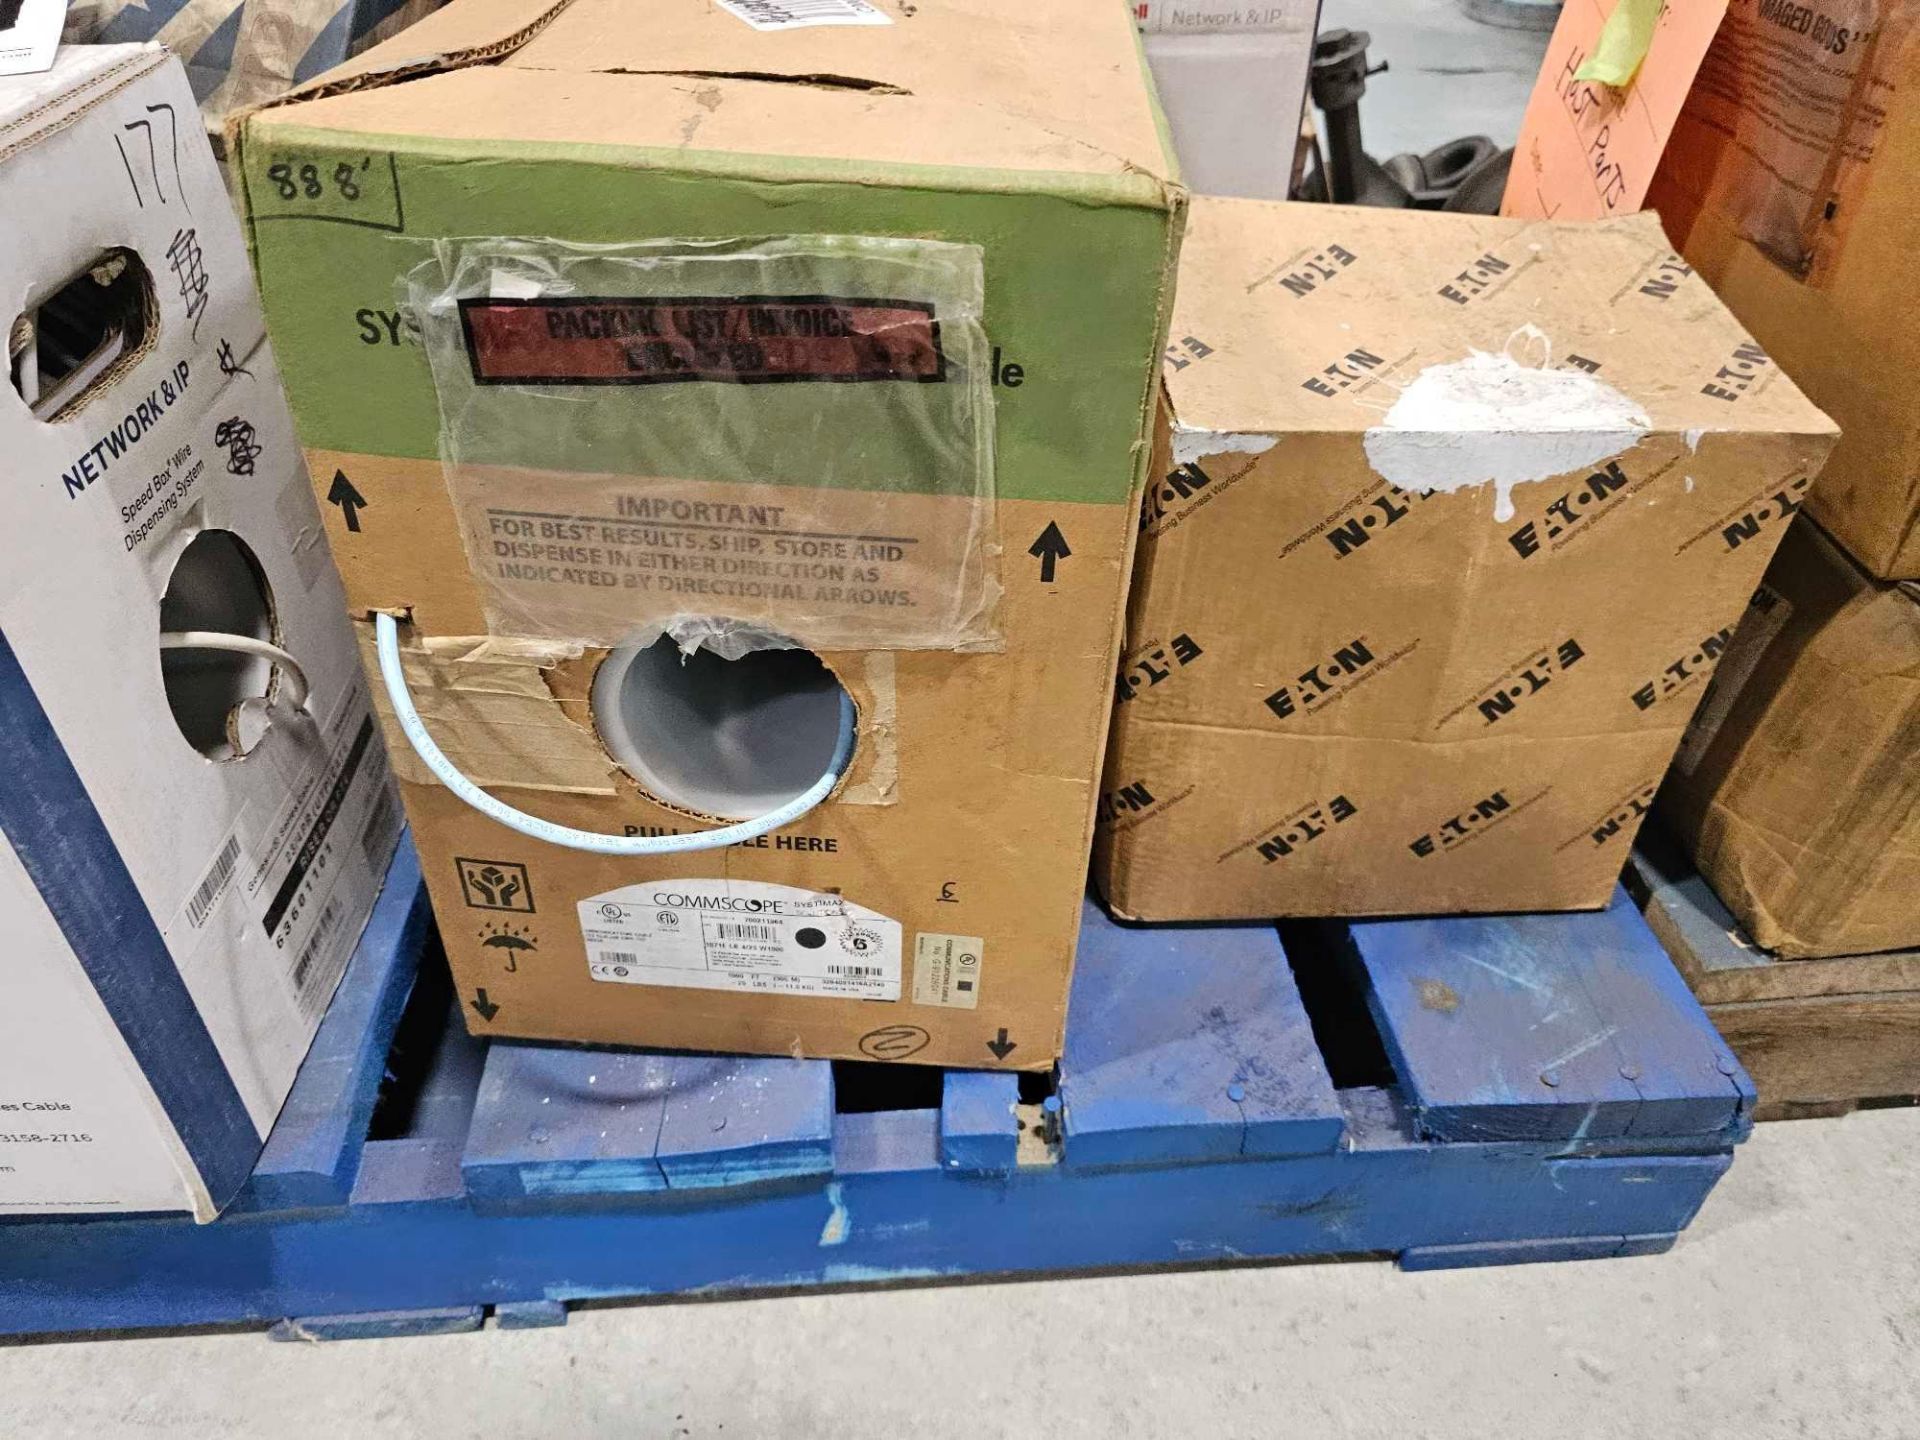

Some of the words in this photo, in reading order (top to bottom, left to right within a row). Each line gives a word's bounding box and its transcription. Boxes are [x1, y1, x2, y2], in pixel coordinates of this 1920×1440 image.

[1172, 9, 1241, 25] Network
[1246, 9, 1258, 25] &
[1264, 9, 1282, 24] IP
[1279, 243, 1358, 299] EATON
[1438, 253, 1510, 305] EATON
[62, 390, 164, 500] NETWORK
[161, 379, 176, 406] &
[173, 360, 190, 393] IP
[121, 483, 154, 524] Speed
[171, 444, 192, 469] Wire
[124, 492, 178, 552] Dispensing
[175, 459, 205, 497] System
[616, 496, 785, 527] IMPORTANT
[1508, 461, 1629, 559] EATON
[489, 517, 536, 539] FOR
[541, 522, 595, 541] BEST
[709, 534, 764, 555] SHIP,
[774, 538, 847, 560] STORE
[852, 545, 904, 562] AND
[493, 540, 601, 565] DISPENSE
[608, 551, 632, 568] IN
[638, 552, 716, 573] EITHER
[722, 557, 845, 581] DIRECTION
[852, 567, 880, 583] AS
[497, 562, 618, 588] INDICATED
[623, 573, 652, 590] BY
[658, 575, 808, 600] DIRECTIONAL
[815, 586, 918, 607] ARROWS.
[1264, 639, 1375, 719] EATON
[1478, 638, 1585, 724] EATON
[776, 835, 838, 852] HERE
[1257, 795, 1358, 863] EATON
[1408, 791, 1510, 858] EATON
[22, 1102, 72, 1111] Cable
